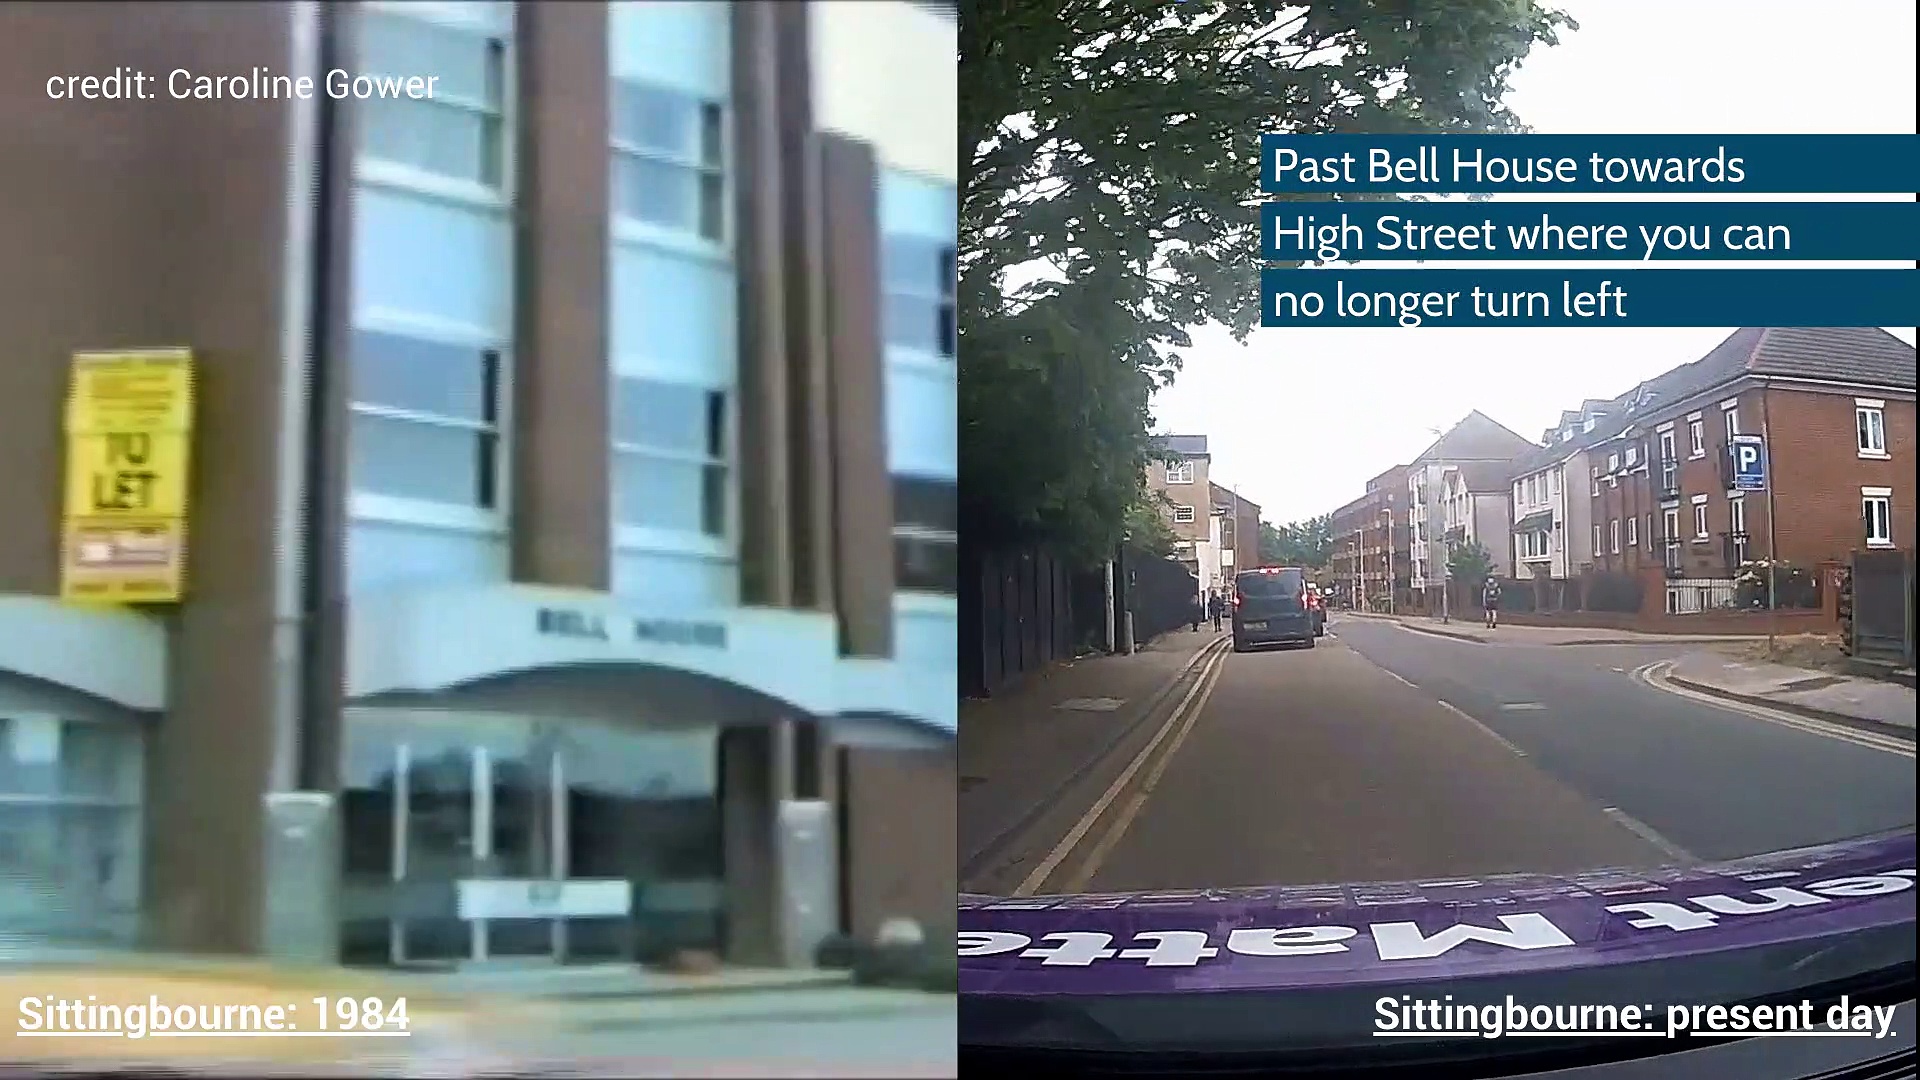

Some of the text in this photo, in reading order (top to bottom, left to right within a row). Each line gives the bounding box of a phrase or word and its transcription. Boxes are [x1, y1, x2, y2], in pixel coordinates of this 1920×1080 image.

[1739, 446, 1757, 472] P
[93, 470, 160, 510] LET
[1605, 869, 1916, 931] ent
